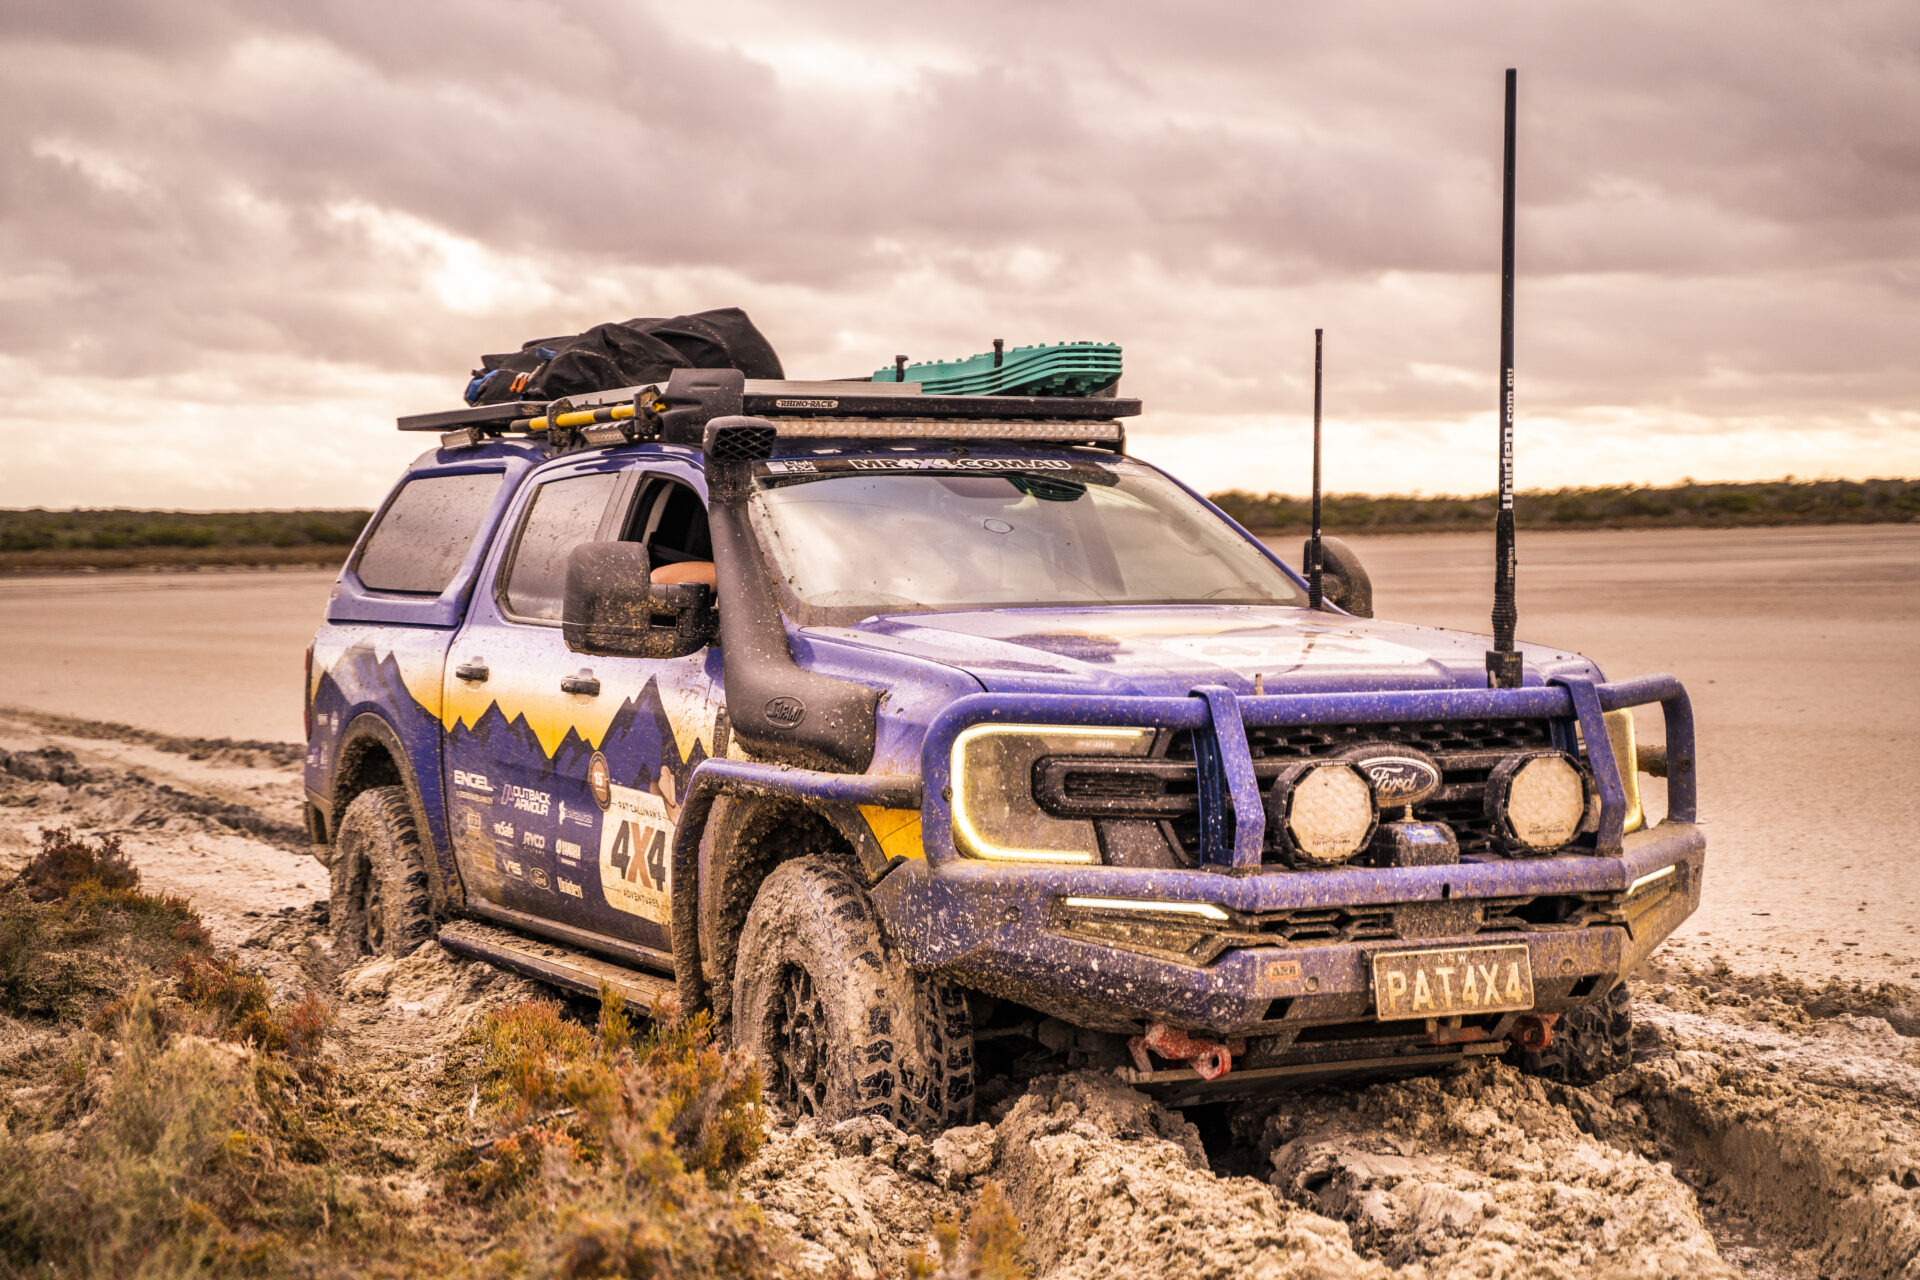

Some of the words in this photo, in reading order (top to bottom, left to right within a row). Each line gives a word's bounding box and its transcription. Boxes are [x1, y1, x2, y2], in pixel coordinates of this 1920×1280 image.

[780, 400, 834, 408] RHINO-RACK
[1370, 767, 1417, 793] Ford
[512, 785, 552, 806] OUTBACK
[513, 798, 549, 817] ARMOUR
[610, 819, 667, 893] 4X4
[1437, 953, 1467, 963] NSW
